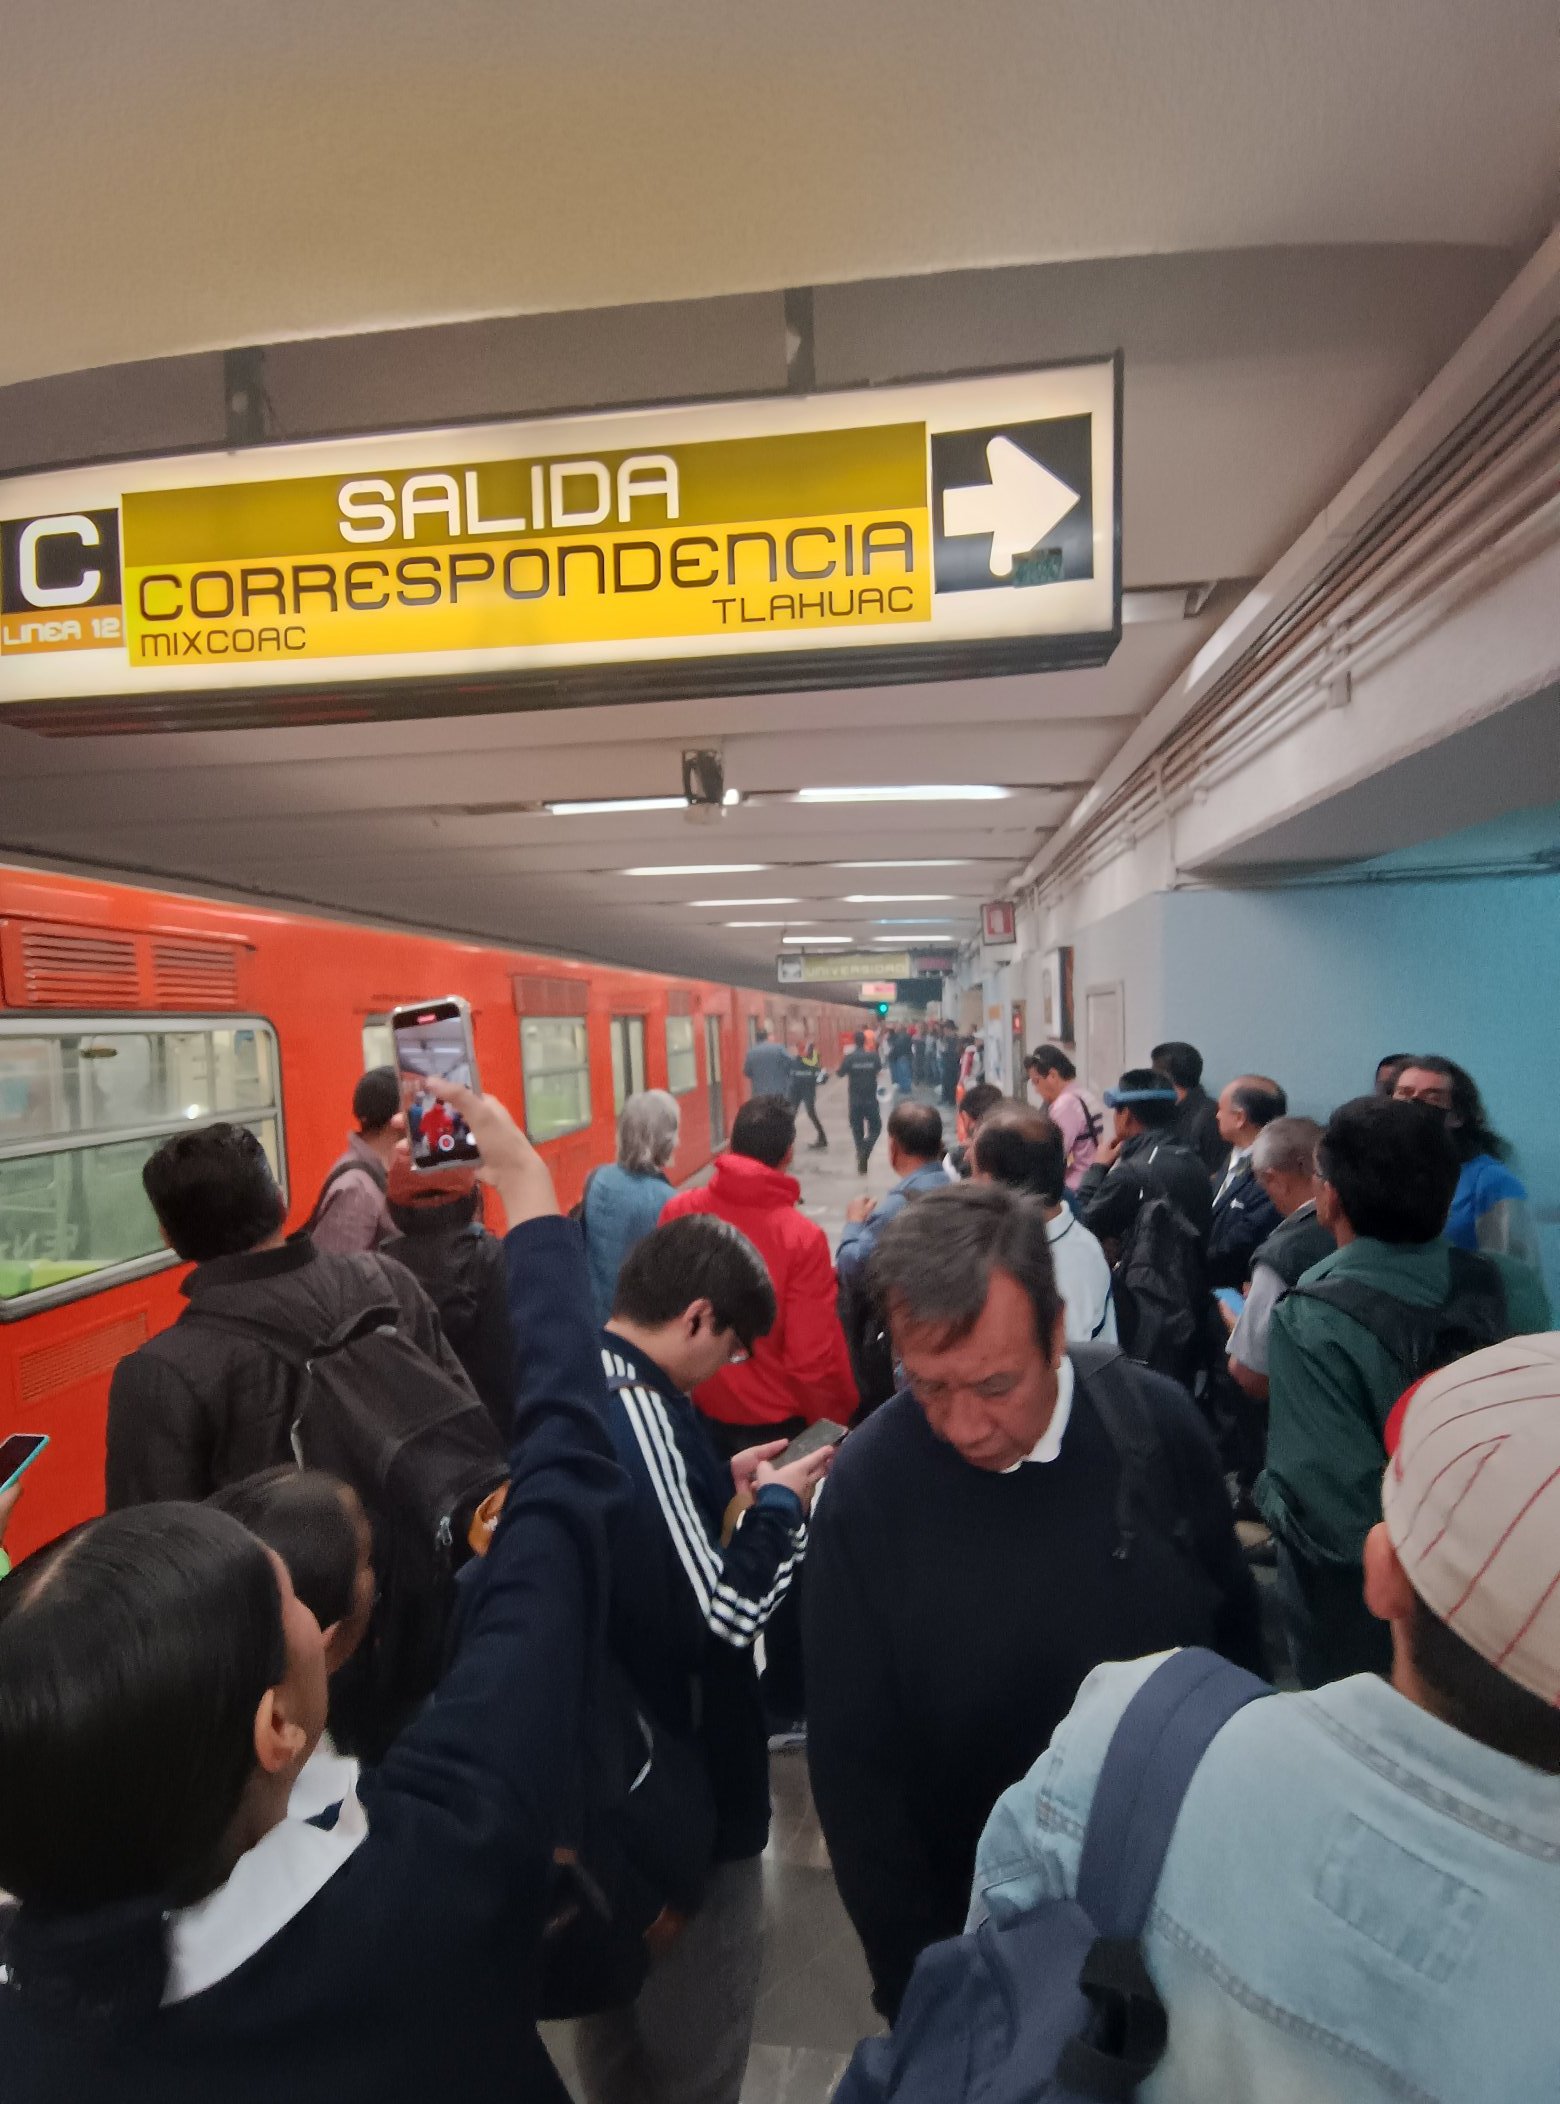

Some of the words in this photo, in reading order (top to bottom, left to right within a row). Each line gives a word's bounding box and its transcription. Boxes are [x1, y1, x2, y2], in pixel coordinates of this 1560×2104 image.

[337, 453, 680, 544] SALIDA
[19, 514, 101, 608] C
[139, 519, 915, 622] CORRESPONDENCIA
[3, 619, 82, 646] LINEA
[91, 616, 121, 639] 12
[711, 585, 915, 625] TLAHUAC
[140, 625, 307, 657] MIXCOAC
